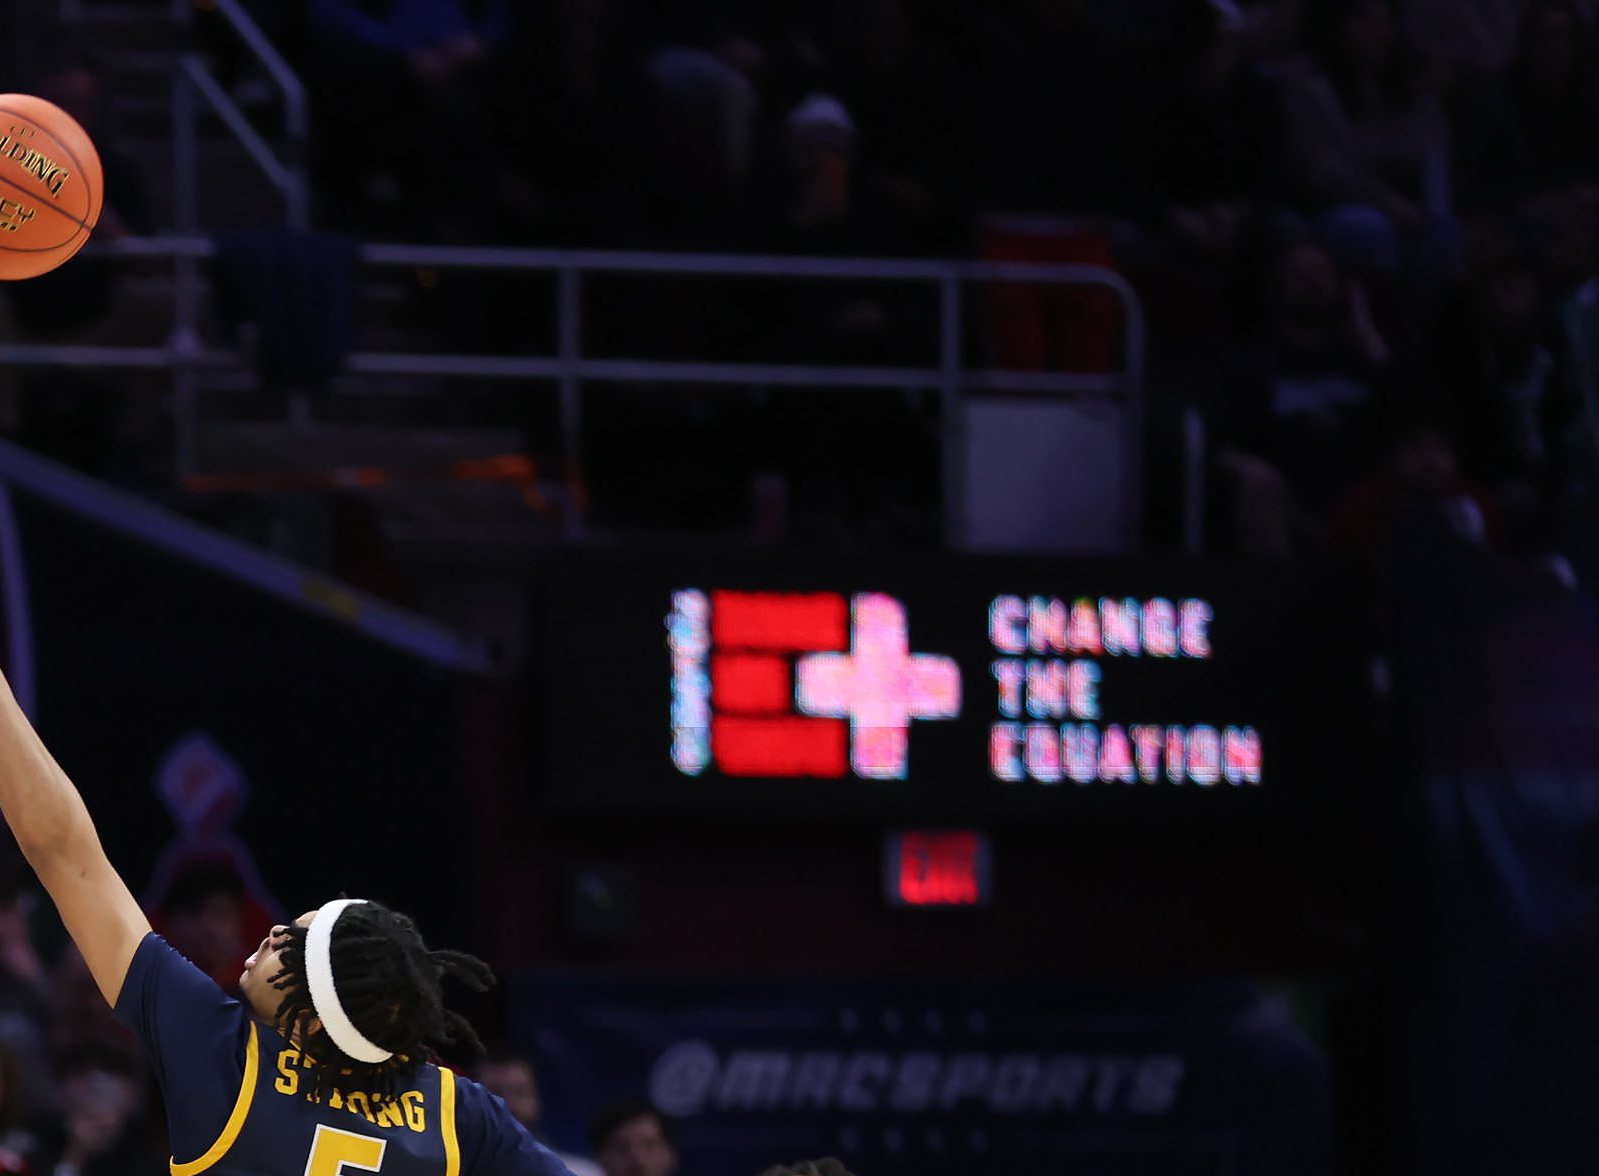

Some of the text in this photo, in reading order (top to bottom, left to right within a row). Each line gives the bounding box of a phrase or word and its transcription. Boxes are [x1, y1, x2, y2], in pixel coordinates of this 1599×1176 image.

[988, 595, 1213, 660] CHANGE
[990, 660, 1103, 720] THE
[988, 723, 1263, 785] EQUATION
[274, 1048, 427, 1133] SONG
[647, 1038, 1188, 1117] @MACSPORTS
